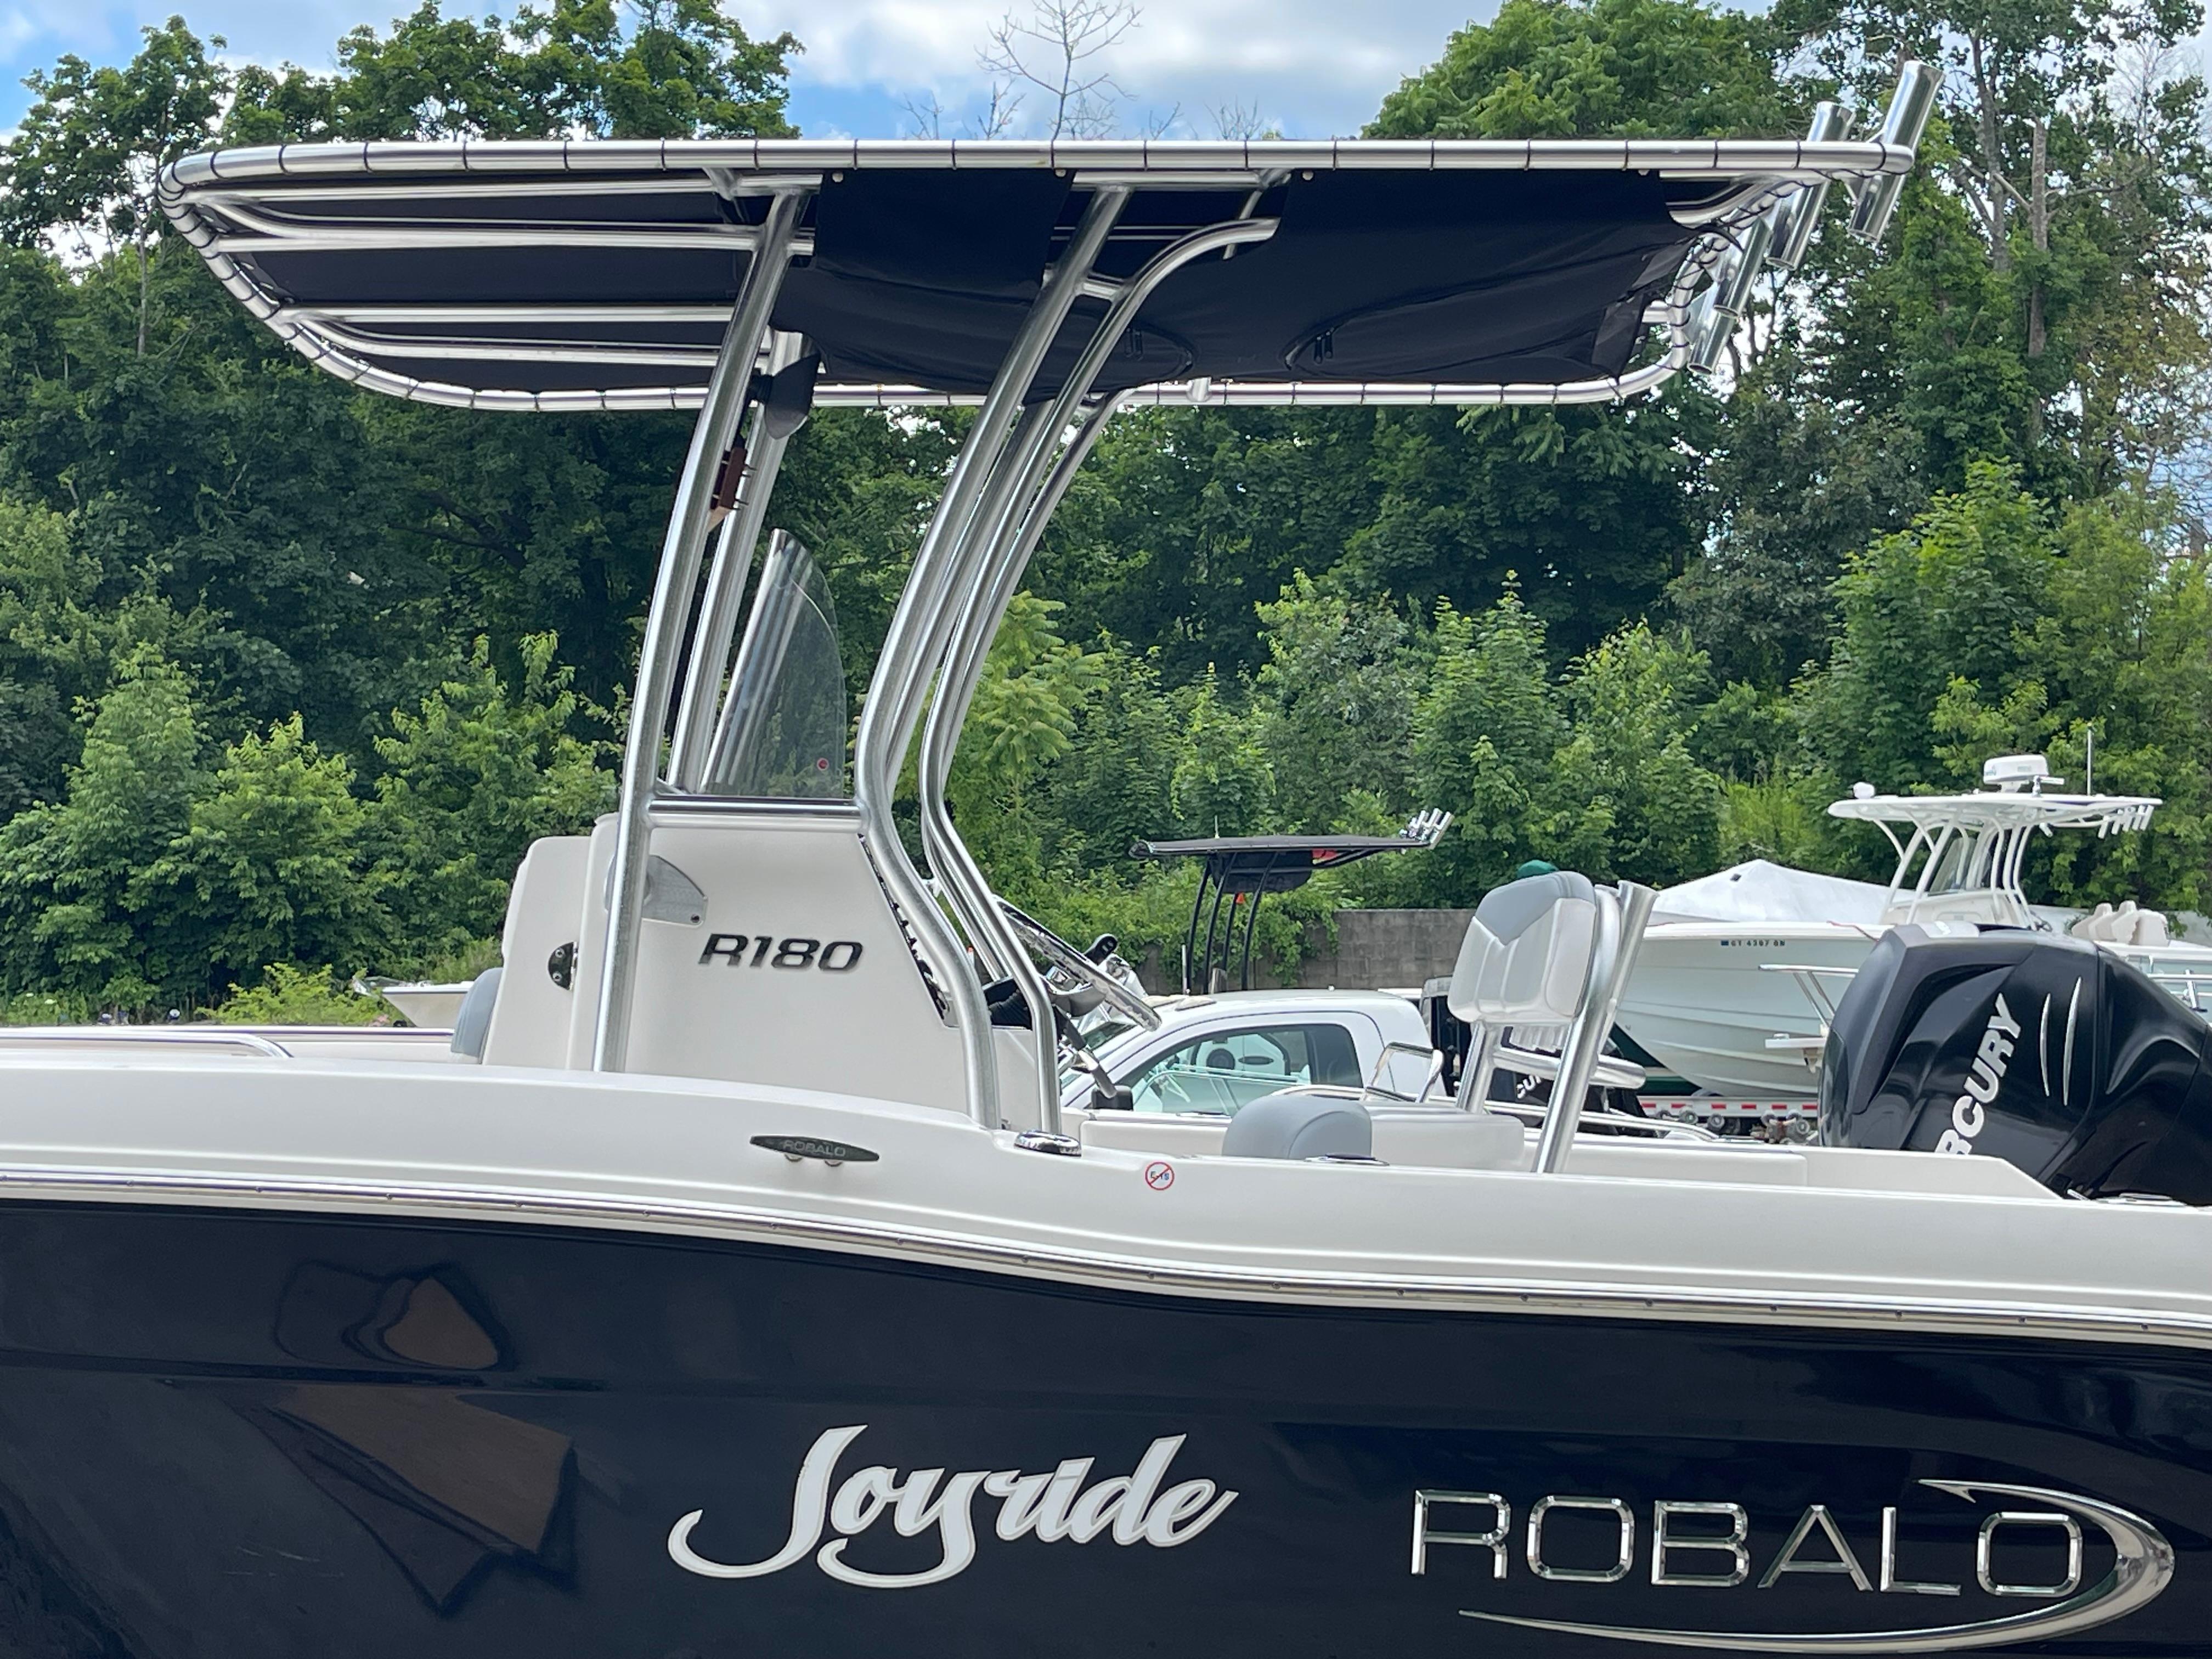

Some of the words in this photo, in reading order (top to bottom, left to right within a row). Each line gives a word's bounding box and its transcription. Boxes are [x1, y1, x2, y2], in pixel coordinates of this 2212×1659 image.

[698, 933, 863, 971] R180
[782, 1139, 846, 1157] ROBALO
[667, 1424, 1240, 1588] Joyride
[1410, 1489, 2084, 1596] ROBALO
